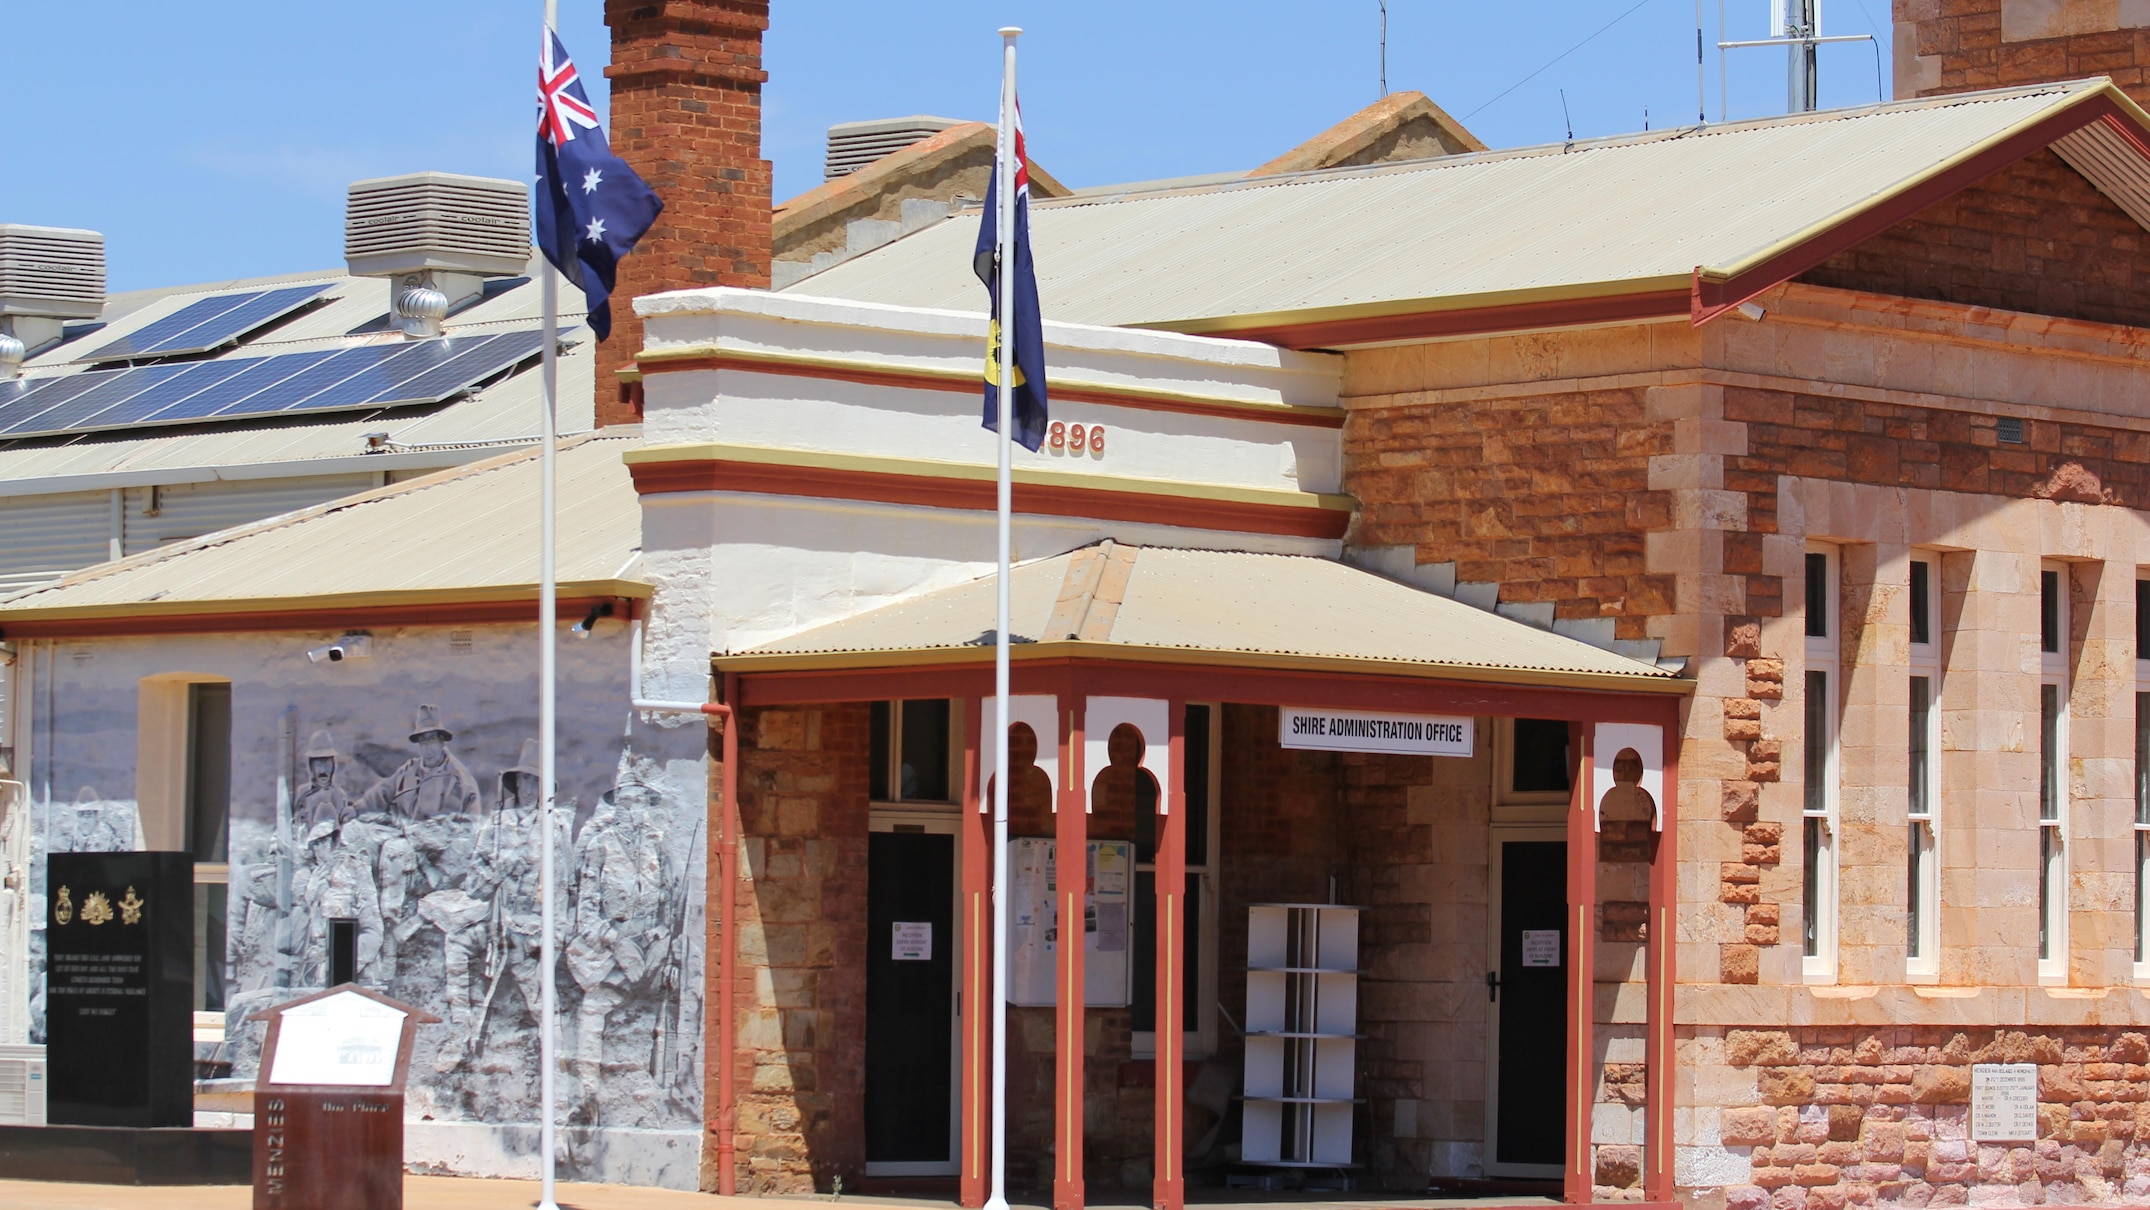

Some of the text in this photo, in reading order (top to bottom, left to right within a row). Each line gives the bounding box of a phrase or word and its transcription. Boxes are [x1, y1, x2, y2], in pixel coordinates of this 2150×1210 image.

[367, 215, 400, 225] coolair
[461, 215, 502, 225] coolair
[38, 264, 77, 272] coolair
[1040, 421, 1105, 452] 896
[1293, 716, 1462, 743] SHIRE ADMINISTRATION OFFICE
[267, 1098, 285, 1195] MENZIES
